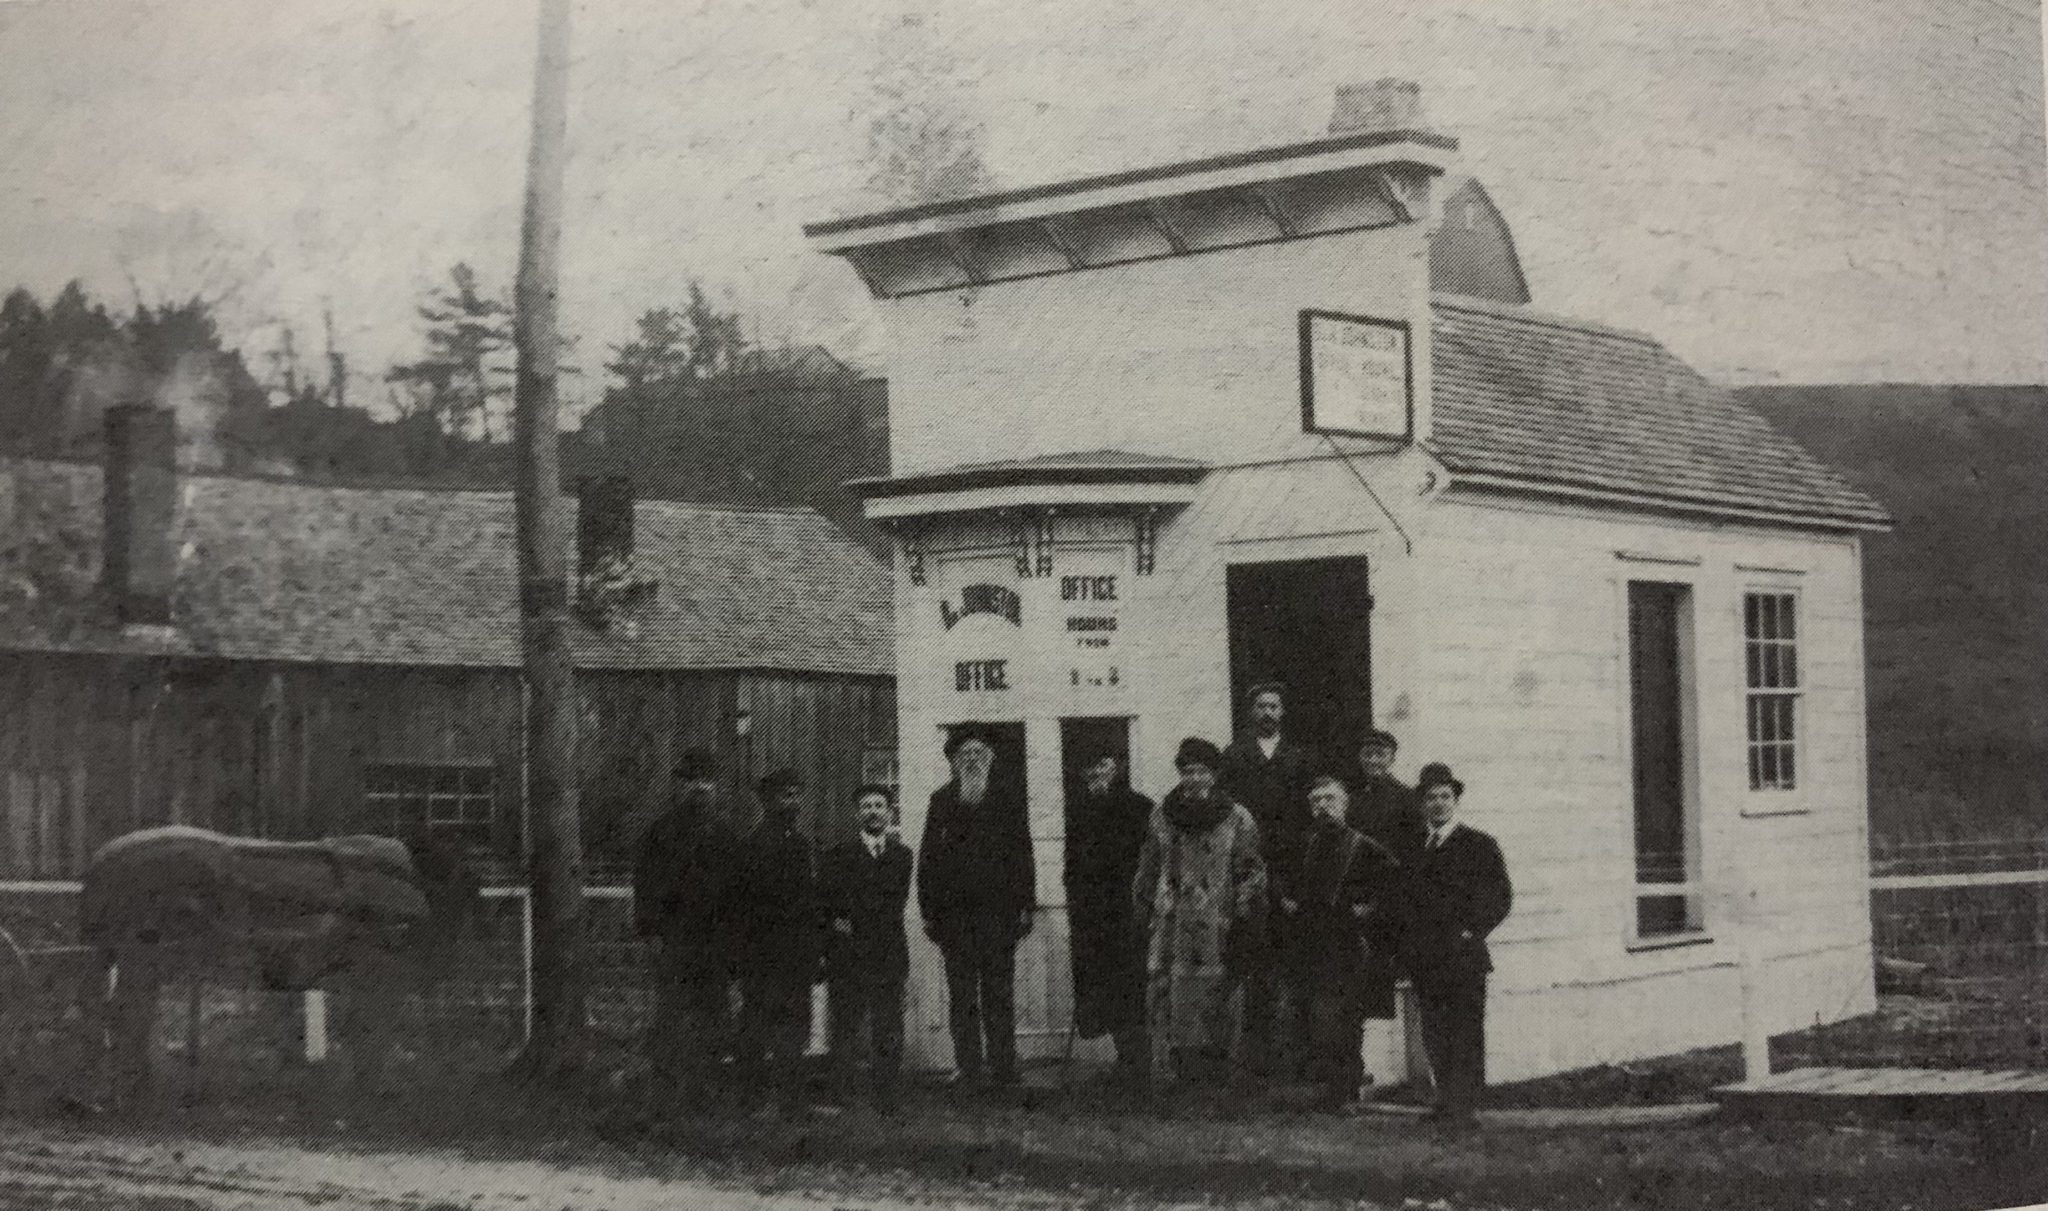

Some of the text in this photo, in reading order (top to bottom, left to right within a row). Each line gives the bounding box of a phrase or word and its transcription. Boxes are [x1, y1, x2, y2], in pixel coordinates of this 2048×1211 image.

[1061, 576, 1118, 601] OFFICE
[1066, 617, 1118, 632] HOURS
[955, 659, 1010, 691] OFFICE
